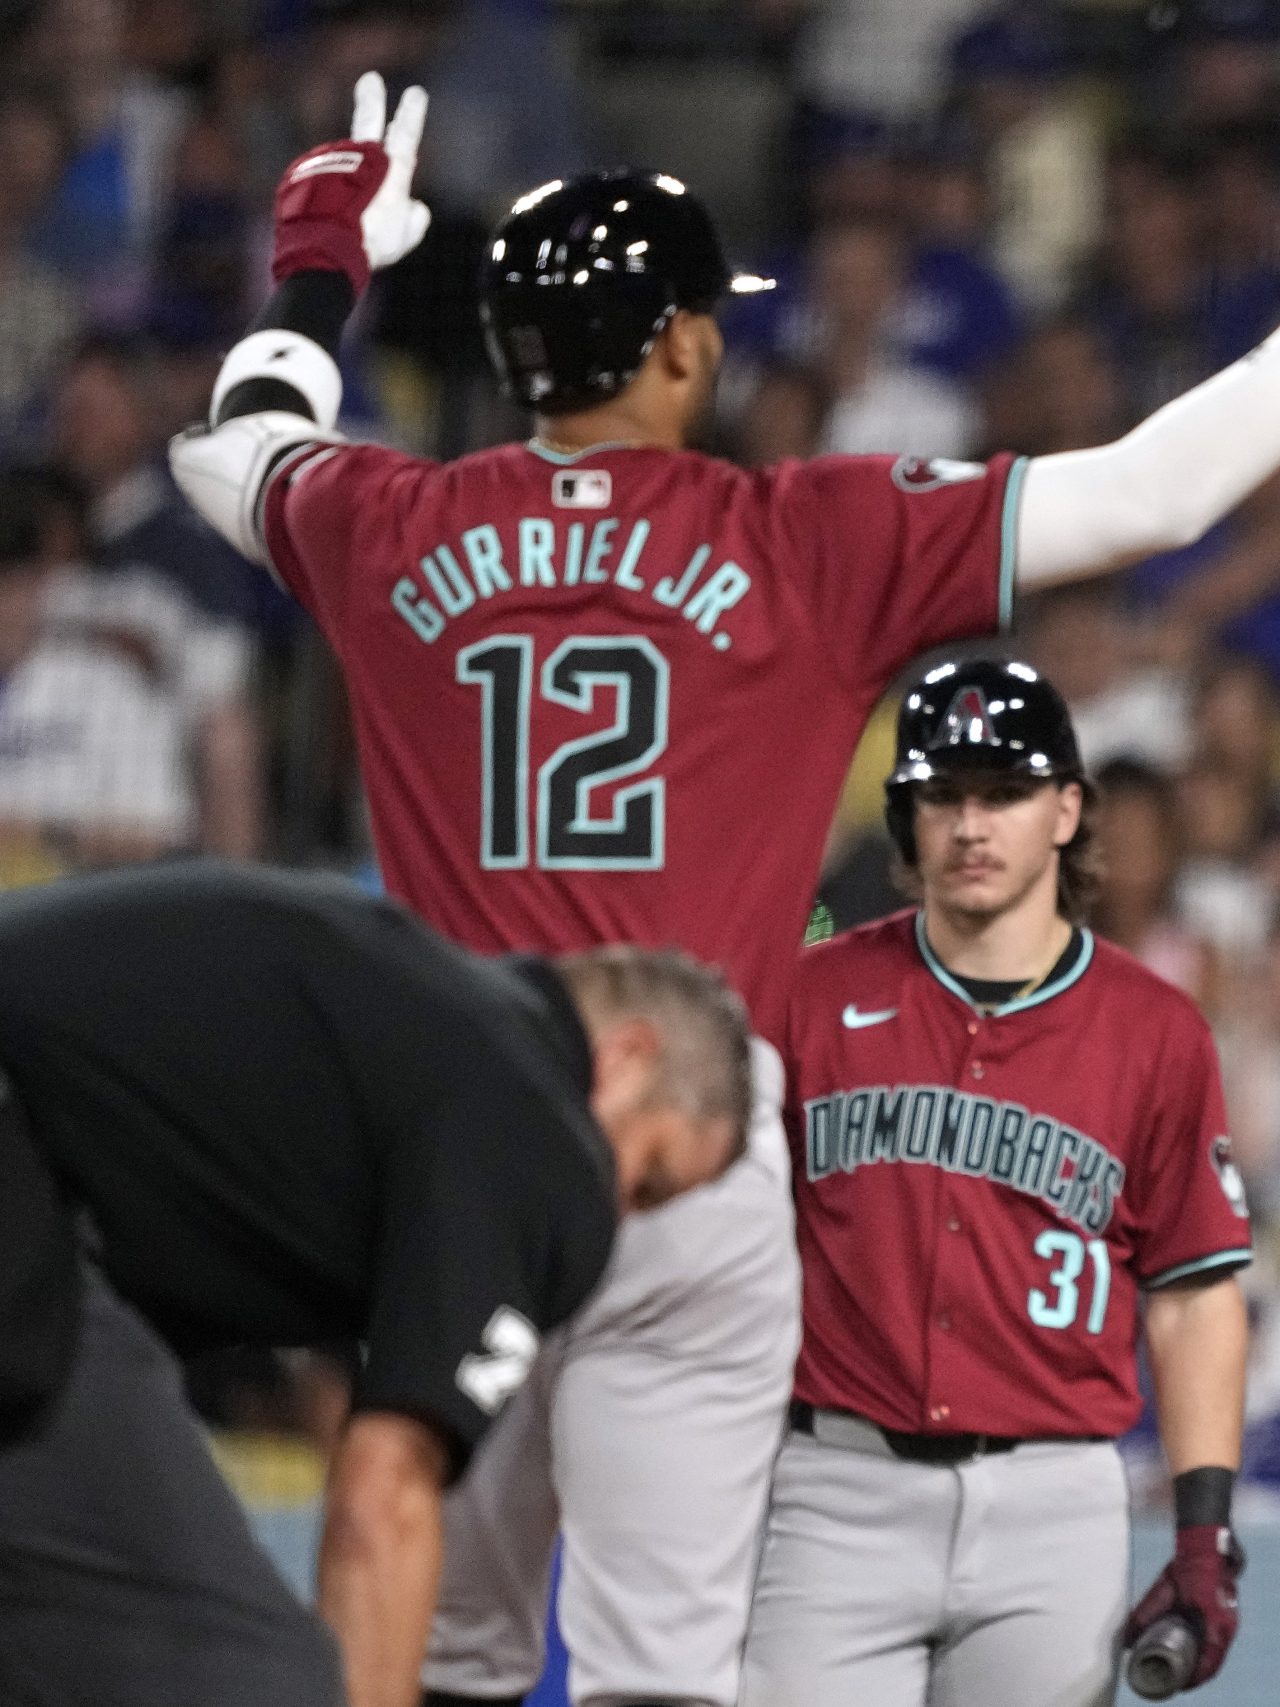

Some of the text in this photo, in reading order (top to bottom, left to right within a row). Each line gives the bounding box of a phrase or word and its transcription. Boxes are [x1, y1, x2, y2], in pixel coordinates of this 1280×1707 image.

[390, 517, 751, 651] GURRIEL JR.
[457, 633, 670, 871] 12
[803, 1084, 1126, 1235] DIAMONDBACKS
[1027, 1229, 1111, 1334] 31
